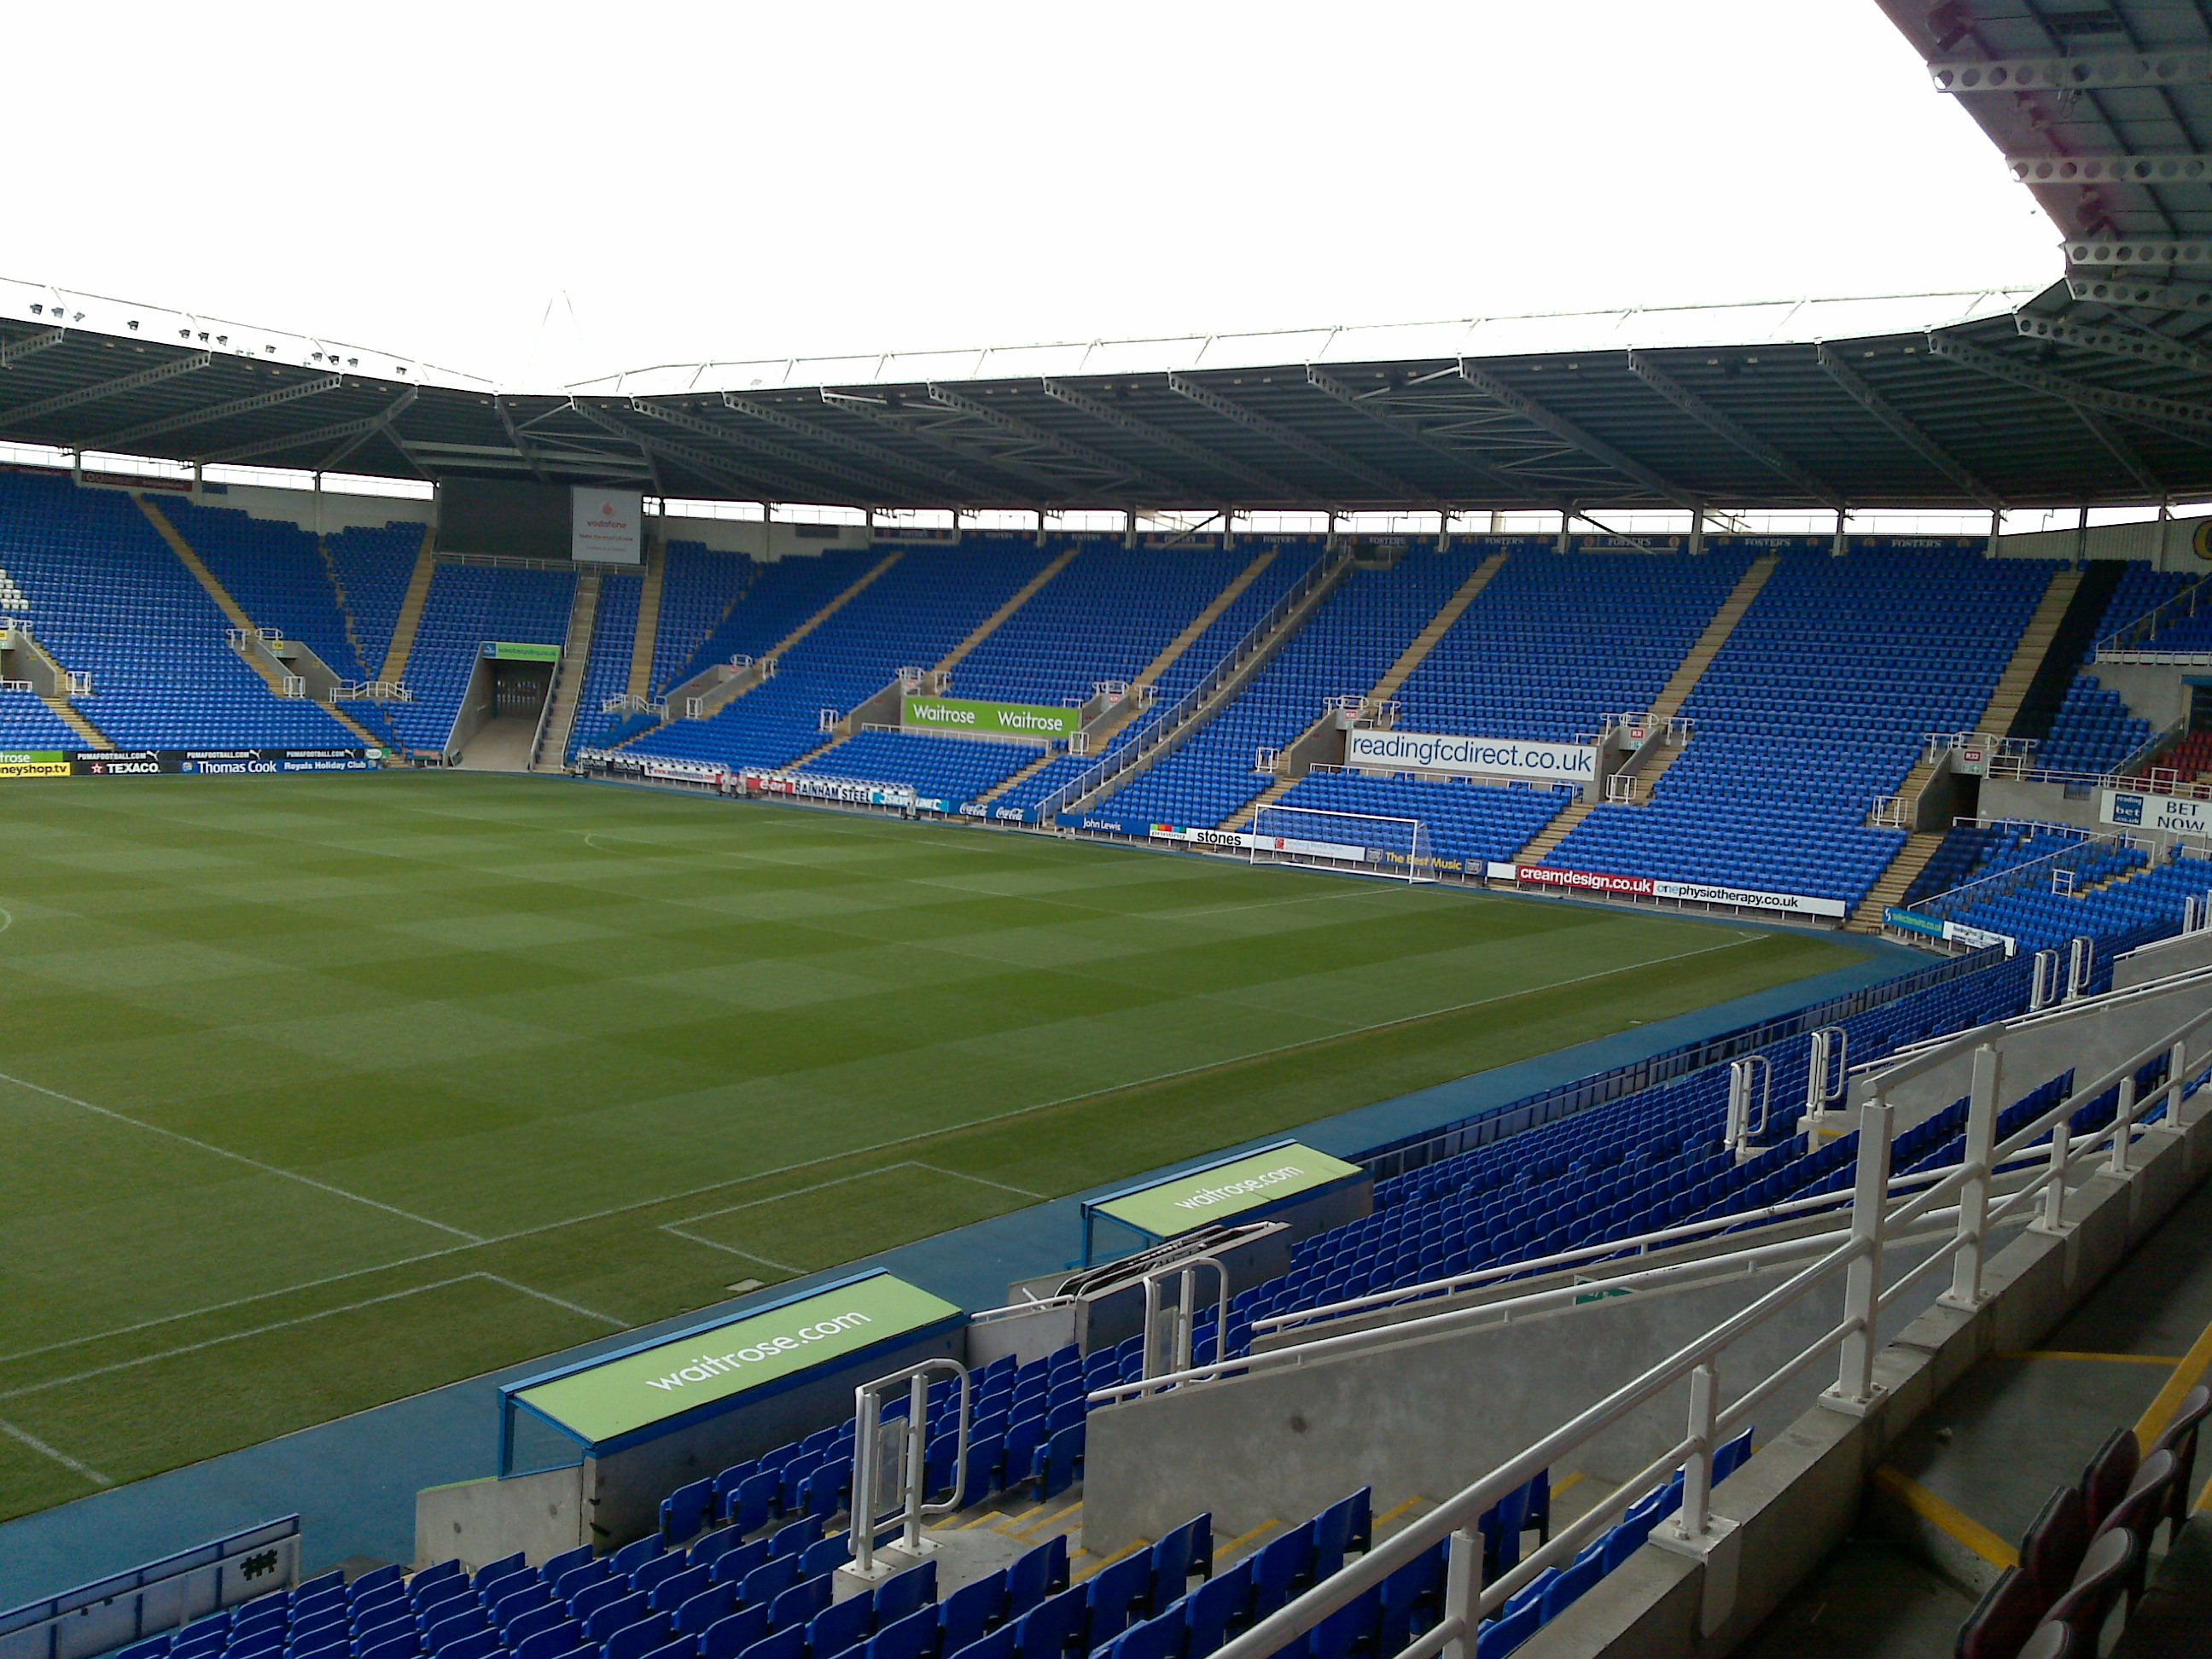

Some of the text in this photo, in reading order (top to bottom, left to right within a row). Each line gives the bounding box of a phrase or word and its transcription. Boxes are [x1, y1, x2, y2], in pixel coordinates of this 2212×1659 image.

[587, 520, 628, 529] vodafone
[912, 703, 975, 725] Waitrose
[998, 710, 1063, 731] Waitrose
[77, 752, 147, 760] PUMAFOOTBALL.COM
[186, 751, 250, 760] PUMAFOOTBALL.COM
[1353, 736, 1592, 772] readingfcdirect.co.uk
[106, 762, 160, 774] TEXACO
[197, 760, 277, 774] Thomas Cook
[284, 760, 366, 771] Royals Holiday Club
[795, 783, 871, 802] RAINHAM STEEL
[2116, 795, 2143, 806] reading
[2116, 806, 2141, 817] bet
[2166, 801, 2199, 816] BET
[1083, 817, 1121, 831] John Lewis
[2157, 816, 2205, 833] NOW
[1197, 830, 1242, 846] stones
[1386, 852, 1405, 864] The
[1406, 853, 1429, 866] Best
[1431, 857, 1463, 871] Music
[1521, 868, 1651, 893] creamdesign.co.uk
[1656, 883, 1798, 908] onephysiotherapy.co.uk
[1174, 1163, 1305, 1211] waitrose.com
[645, 1307, 872, 1393] waitrose.com
